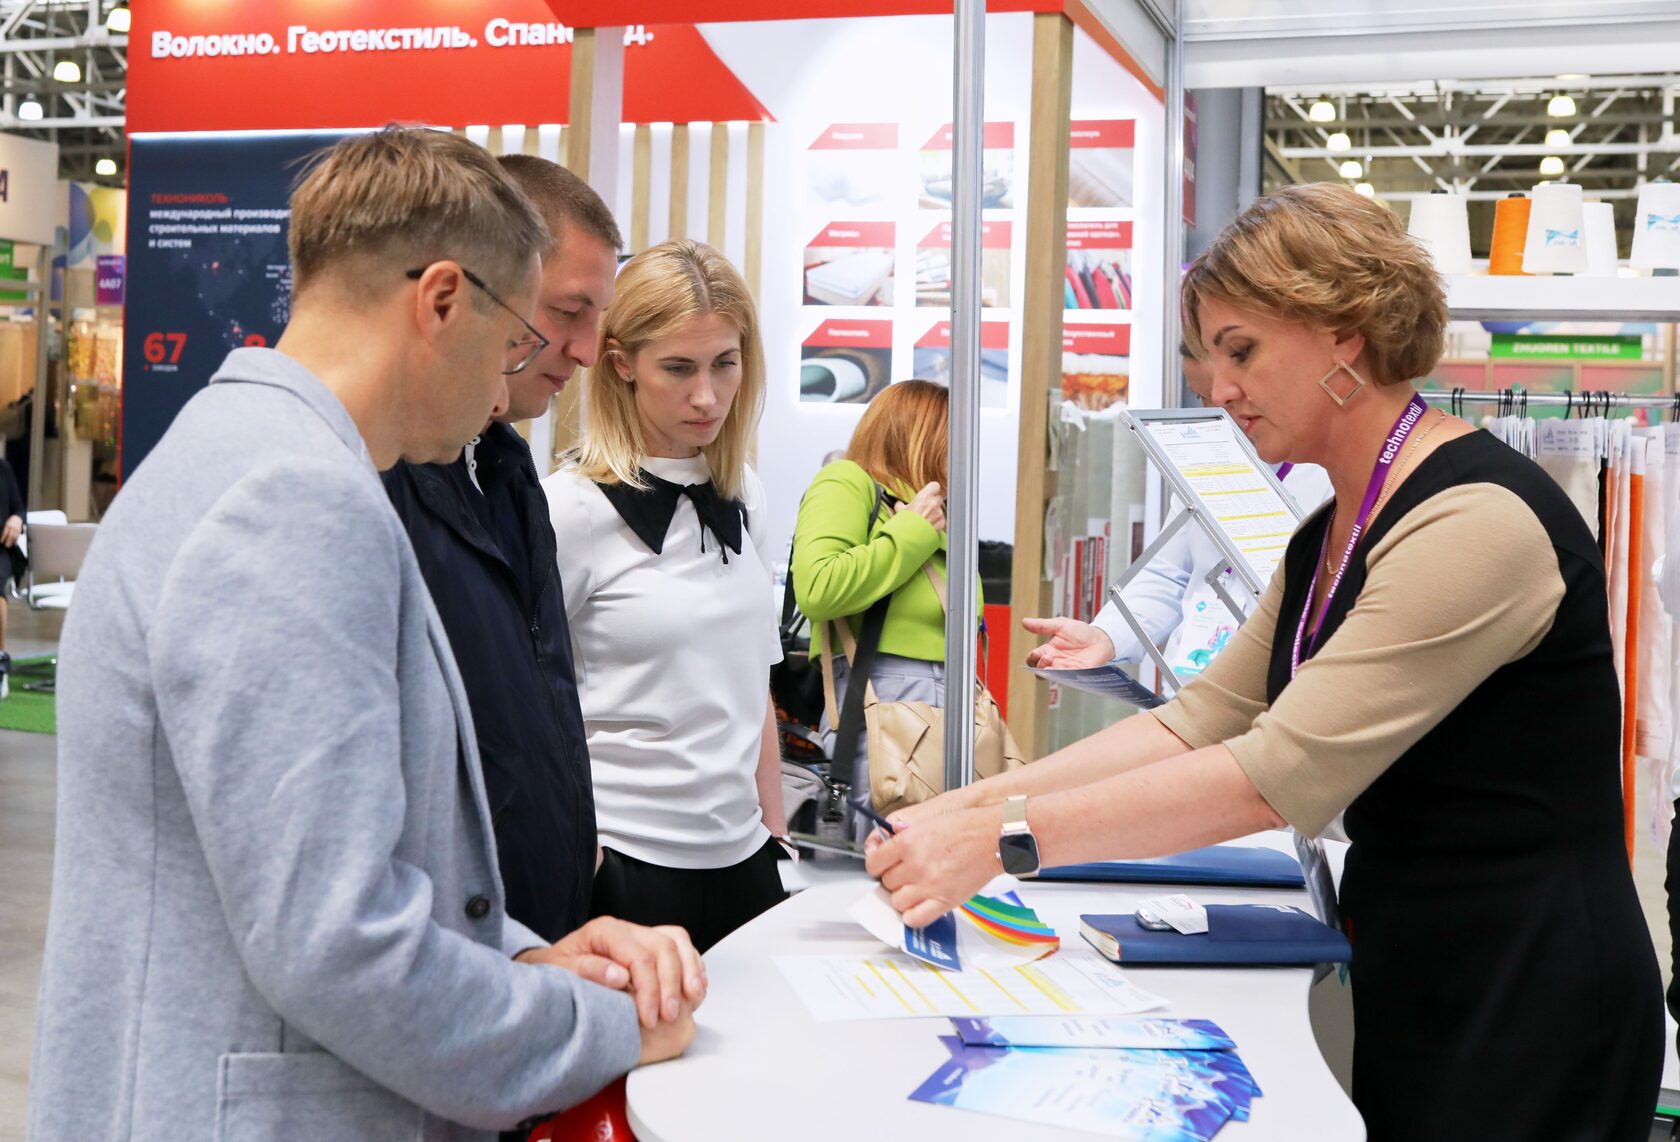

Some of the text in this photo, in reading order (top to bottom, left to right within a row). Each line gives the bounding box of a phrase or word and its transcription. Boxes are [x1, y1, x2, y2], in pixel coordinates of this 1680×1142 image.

[151, 30, 281, 58] Волокно.
[287, 24, 479, 53] Геотекстиль.
[149, 207, 232, 221] международный
[149, 223, 281, 235] строительных материалов
[148, 238, 192, 248] и систем
[143, 331, 187, 364] 67
[1379, 401, 1424, 465] technotextil
[1328, 524, 1362, 599] technotextil
